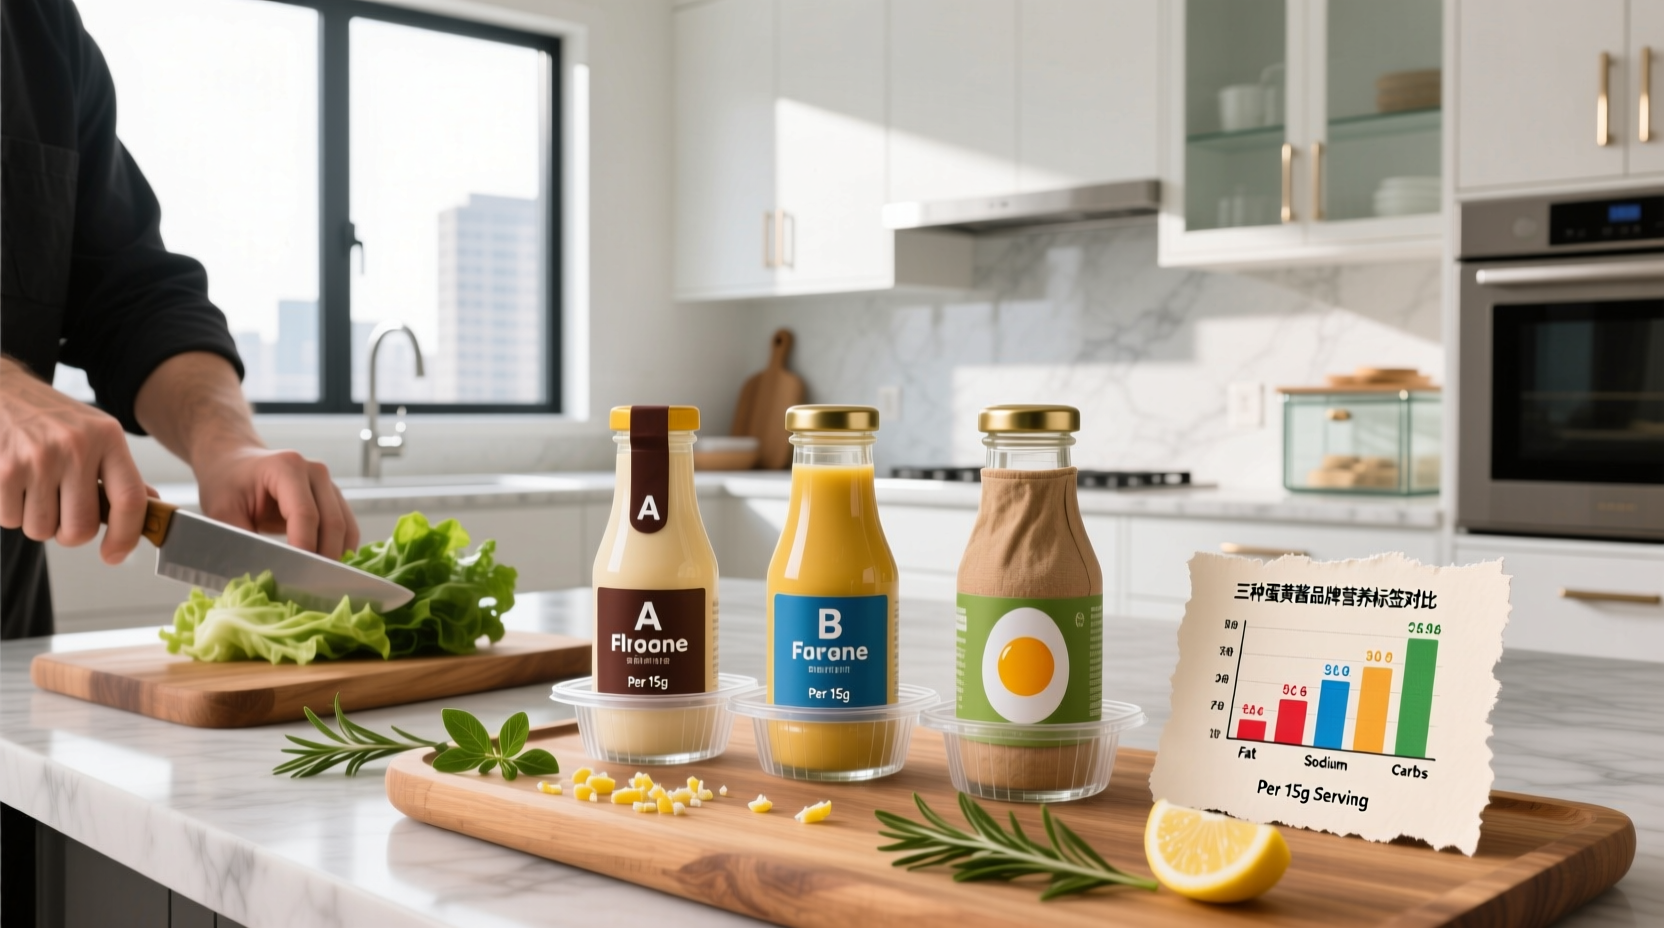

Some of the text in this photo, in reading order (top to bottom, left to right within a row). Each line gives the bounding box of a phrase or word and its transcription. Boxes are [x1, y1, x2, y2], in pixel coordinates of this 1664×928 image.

[637, 495, 660, 521] A
[1234, 582, 1437, 609] 三种蛋黄酱品牌营养标签对比
[634, 601, 662, 631] A
[819, 608, 842, 639] B
[628, 675, 668, 690] Per 15g
[830, 687, 850, 703] 15g
[1238, 746, 1256, 760] Fat
[1304, 755, 1348, 771] Sodium
[1391, 764, 1428, 779] Carbs
[1257, 779, 1369, 811] Per 15g Serving
